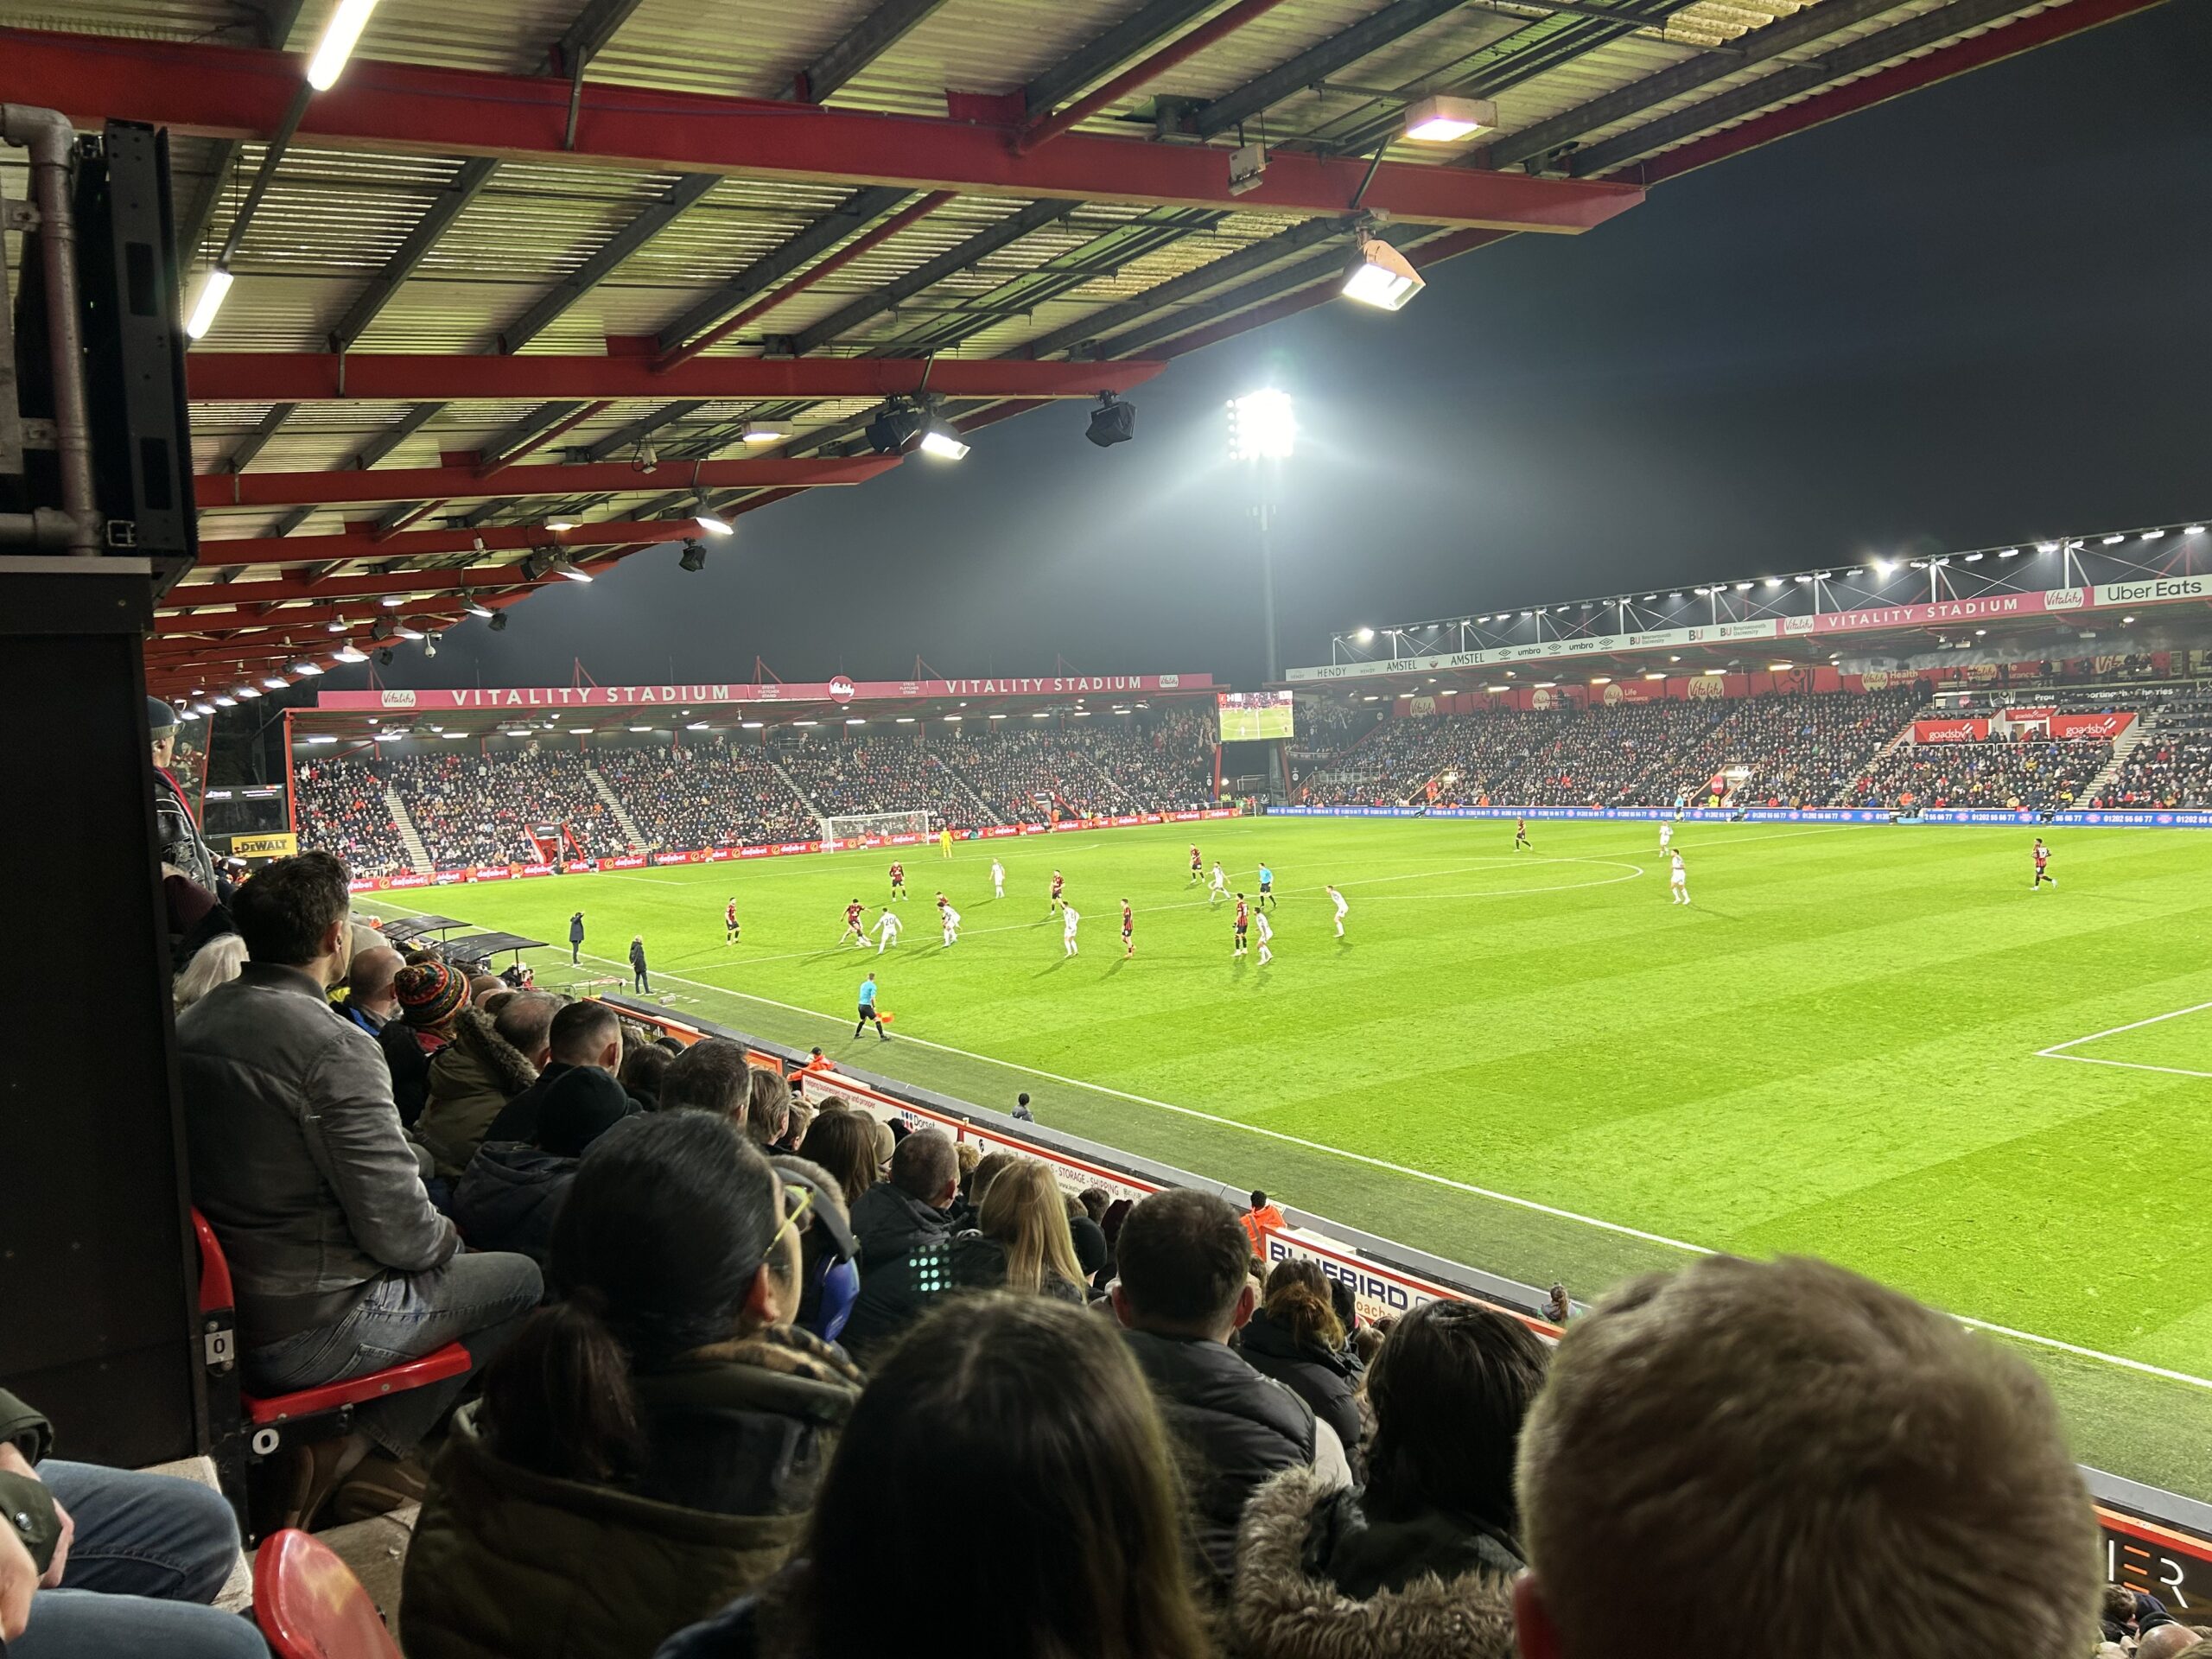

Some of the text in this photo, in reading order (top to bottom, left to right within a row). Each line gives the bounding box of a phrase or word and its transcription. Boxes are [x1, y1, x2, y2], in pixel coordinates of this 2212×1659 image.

[2107, 580, 2202, 601] Uber Eats
[2046, 591, 2082, 607] Vitality
[1828, 598, 2018, 627] VITALITY STADIUM
[1720, 626, 1732, 637] BU
[1785, 619, 1813, 631] Vitality
[1630, 636, 1641, 645] BU
[1688, 629, 1703, 641] BU
[1569, 642, 1594, 651] umbro
[1386, 659, 1417, 672] AMSTEL
[1451, 652, 1484, 666] AMSTEL
[1317, 667, 1347, 678] HENDY
[946, 676, 1141, 694] VITALITY STADIUM
[1689, 679, 1723, 698] Vitality
[384, 691, 415, 703] Vitality
[452, 684, 729, 706] VITALITY STADIUM
[1624, 688, 1637, 696] Life
[1929, 728, 1966, 741] goadsby
[2065, 723, 2108, 736] goadsby
[391, 877, 424, 887] dafabet
[885, 917, 894, 926] 20
[1058, 1166, 1086, 1185] STORAGE
[1090, 1177, 1120, 1196] SHIPPING
[1270, 1241, 1408, 1311] BEBIRD
